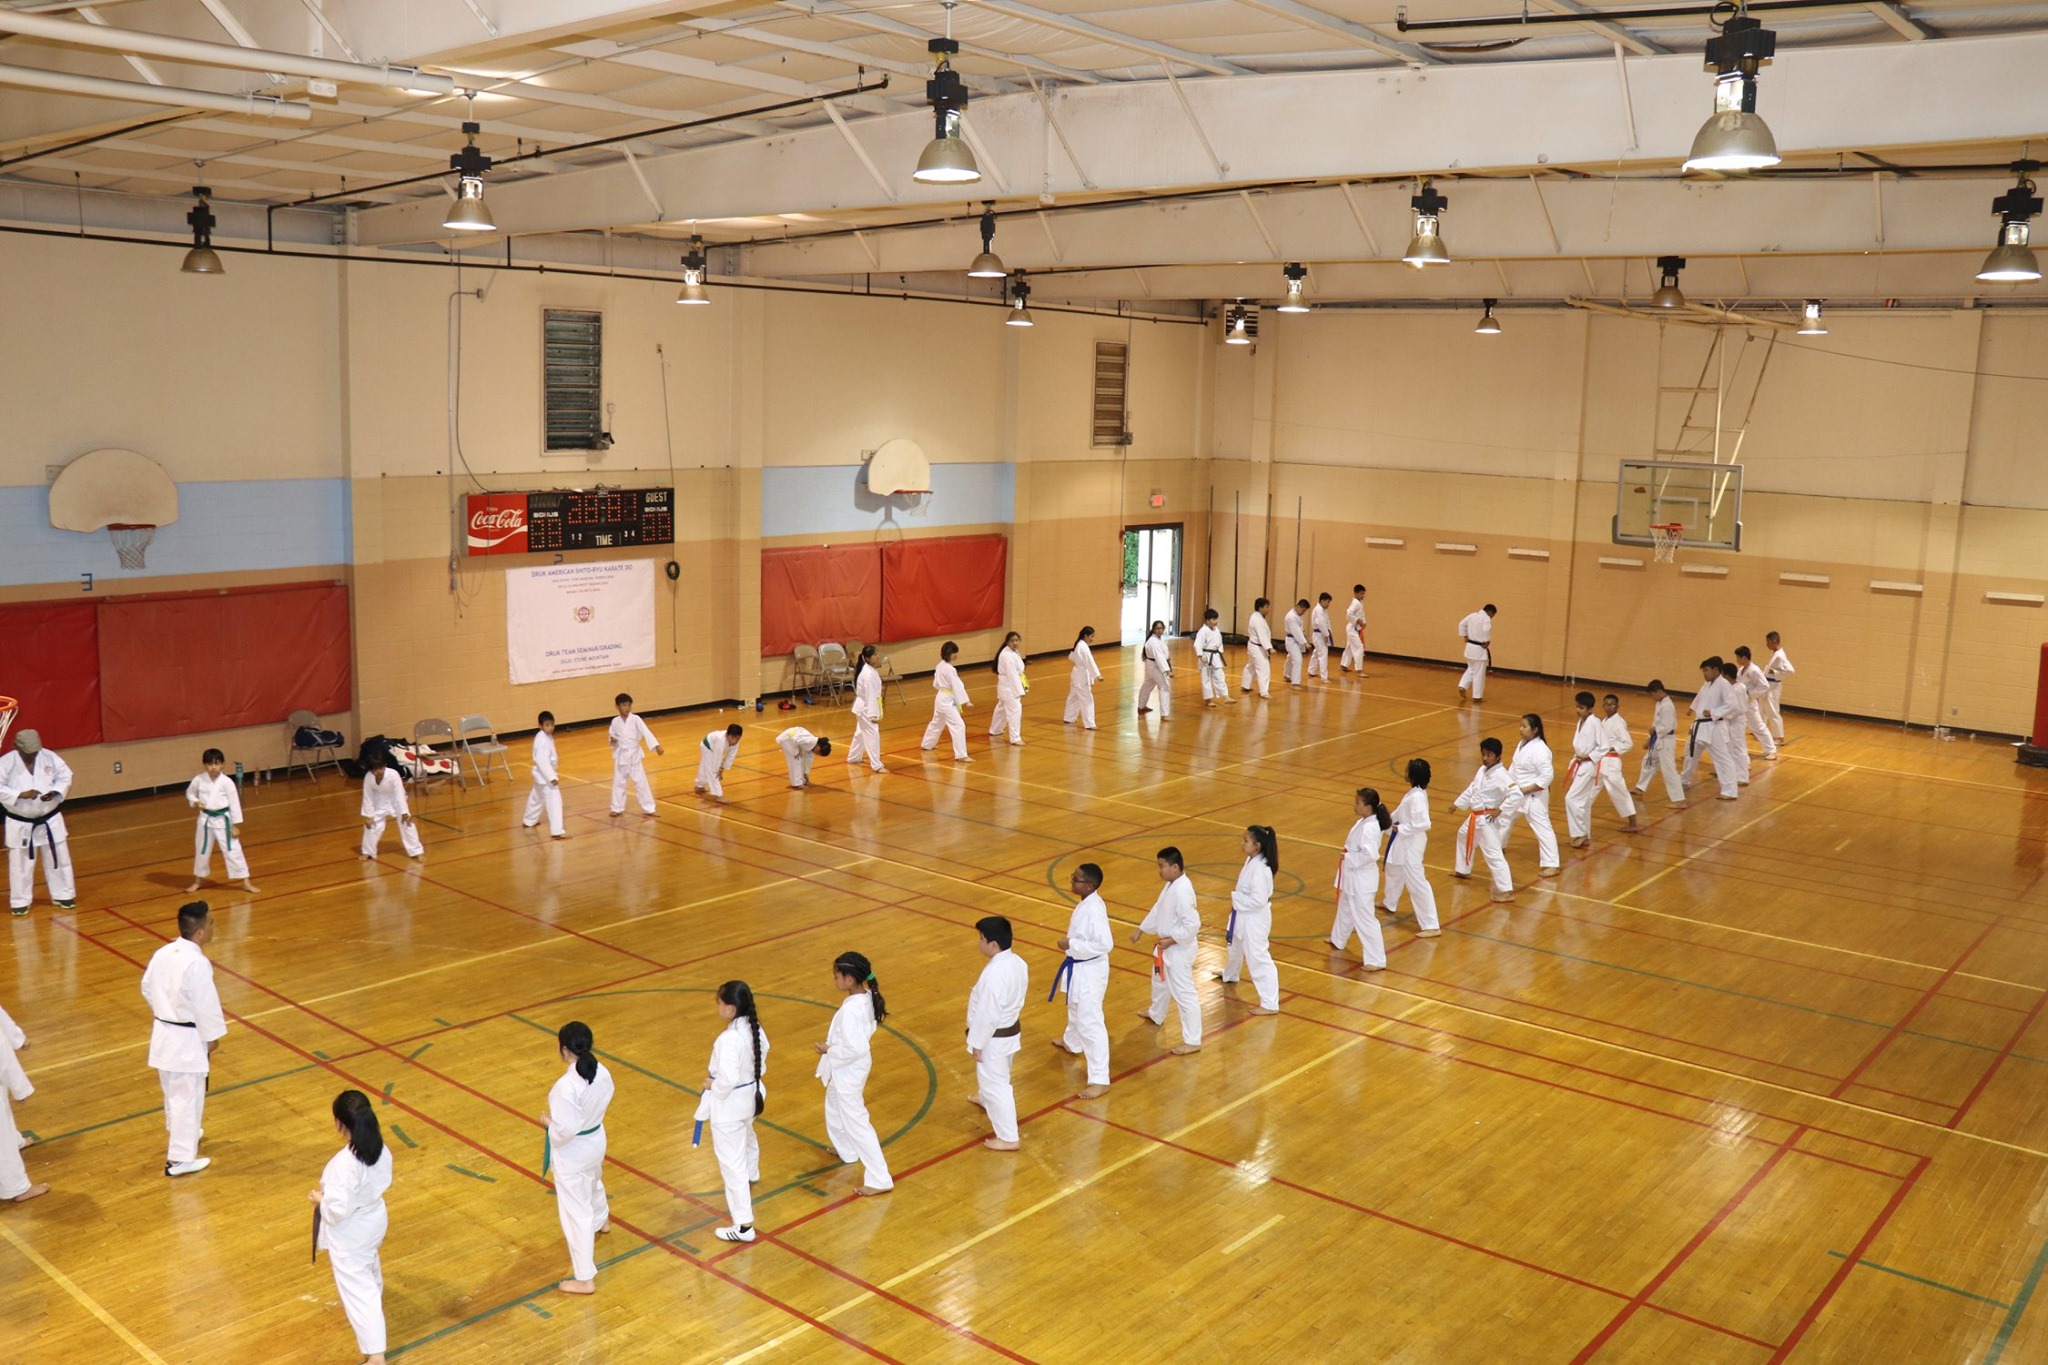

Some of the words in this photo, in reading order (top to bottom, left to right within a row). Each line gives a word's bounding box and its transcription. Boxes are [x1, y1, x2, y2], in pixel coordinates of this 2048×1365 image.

[645, 491, 668, 503] GUEST
[471, 508, 524, 530] Coca-Cola
[533, 511, 559, 519] BONUS
[595, 534, 613, 546] TIME
[548, 568, 574, 576] AMERICAN
[575, 566, 603, 574] SHITO-RYU
